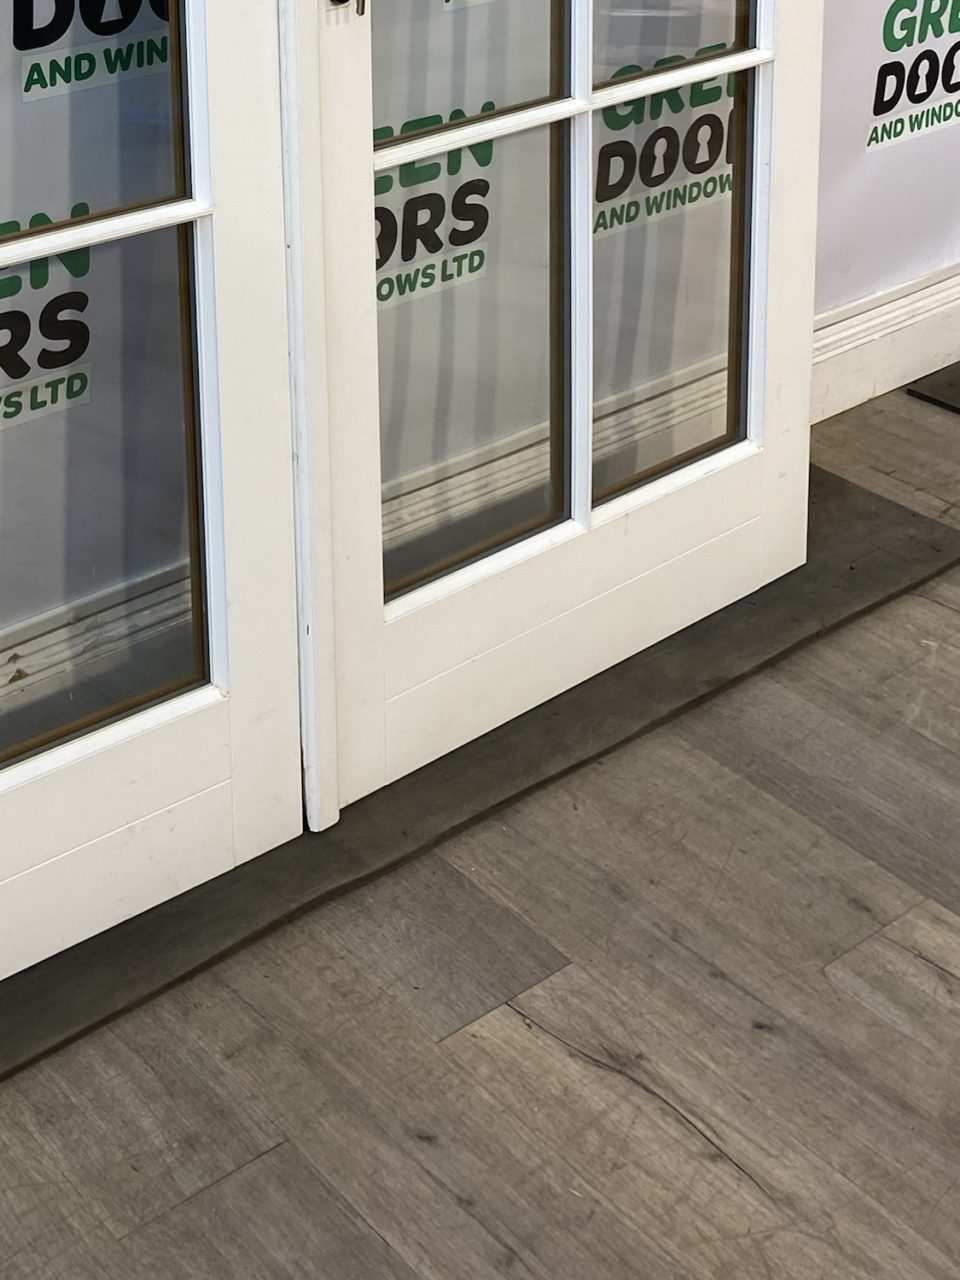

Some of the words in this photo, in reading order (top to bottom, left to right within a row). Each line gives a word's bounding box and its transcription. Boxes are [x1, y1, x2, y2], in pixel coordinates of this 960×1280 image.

[23, 51, 97, 93] AND
[866, 117, 905, 148] AND
[593, 200, 641, 234] AND
[440, 249, 485, 283] LTD
[29, 371, 89, 412] LTD
